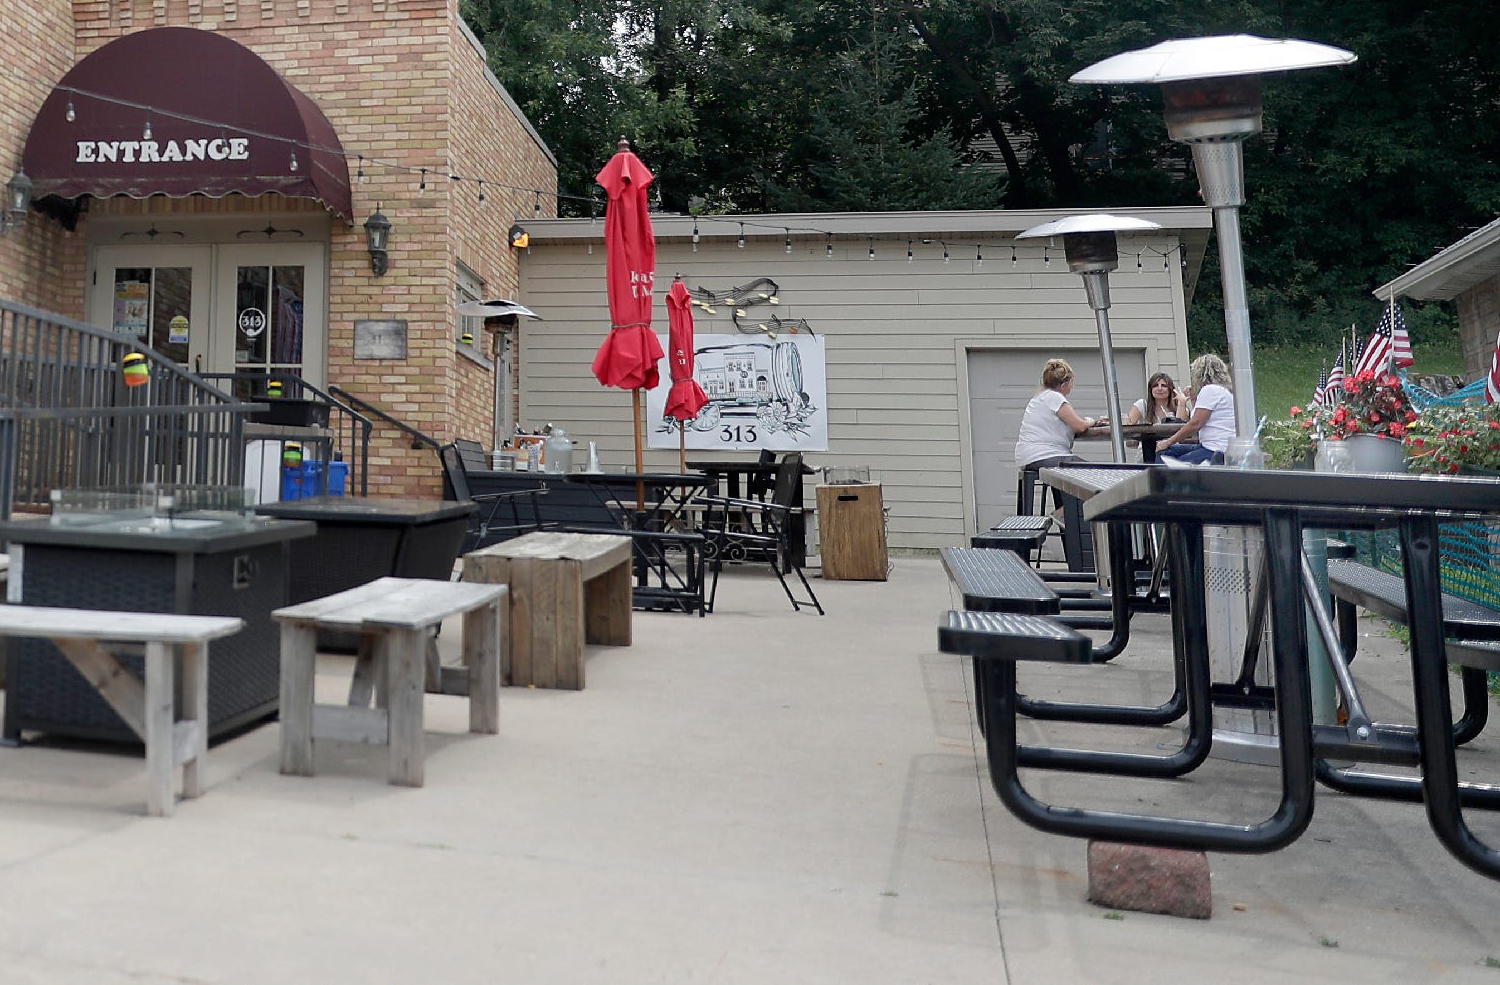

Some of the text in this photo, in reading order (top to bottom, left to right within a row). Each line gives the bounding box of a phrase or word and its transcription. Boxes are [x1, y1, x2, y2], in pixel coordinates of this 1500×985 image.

[76, 137, 249, 163] ENTRANCE
[241, 315, 262, 328] 313
[719, 424, 757, 443] 313
